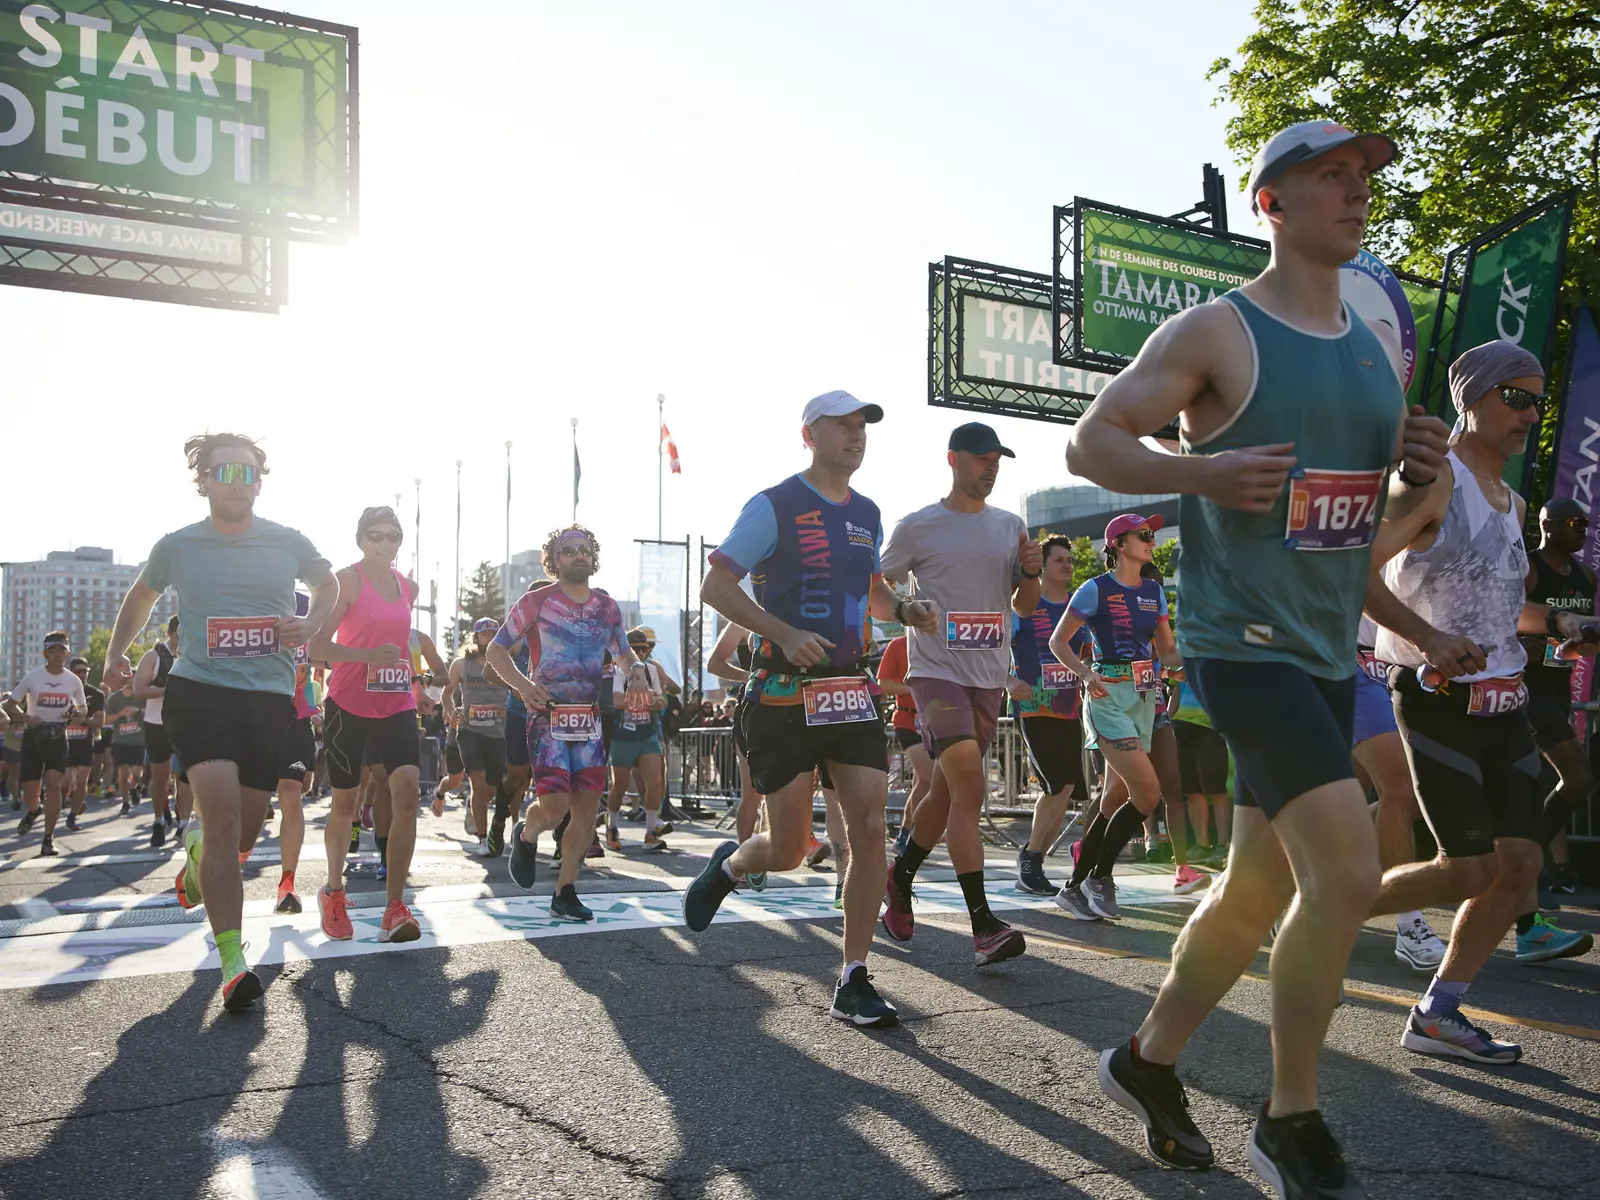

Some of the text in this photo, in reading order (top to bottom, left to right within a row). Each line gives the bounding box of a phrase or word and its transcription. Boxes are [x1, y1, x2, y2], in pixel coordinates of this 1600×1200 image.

[17, 4, 265, 103] START
[1093, 245, 1108, 258] FIN
[1110, 250, 1121, 261] DE
[1123, 252, 1161, 269] SEMAINE
[1163, 261, 1178, 273] DES
[1180, 264, 1217, 281] COURSES
[1093, 300, 1147, 323] OTTAWA
[1314, 495, 1377, 531] 1874
[795, 509, 832, 619] OTTAWA
[219, 627, 275, 648] 2950
[959, 623, 1000, 641] 2771
[377, 668, 409, 683] 1024
[1366, 661, 1387, 678] 16
[817, 689, 867, 713] 2986
